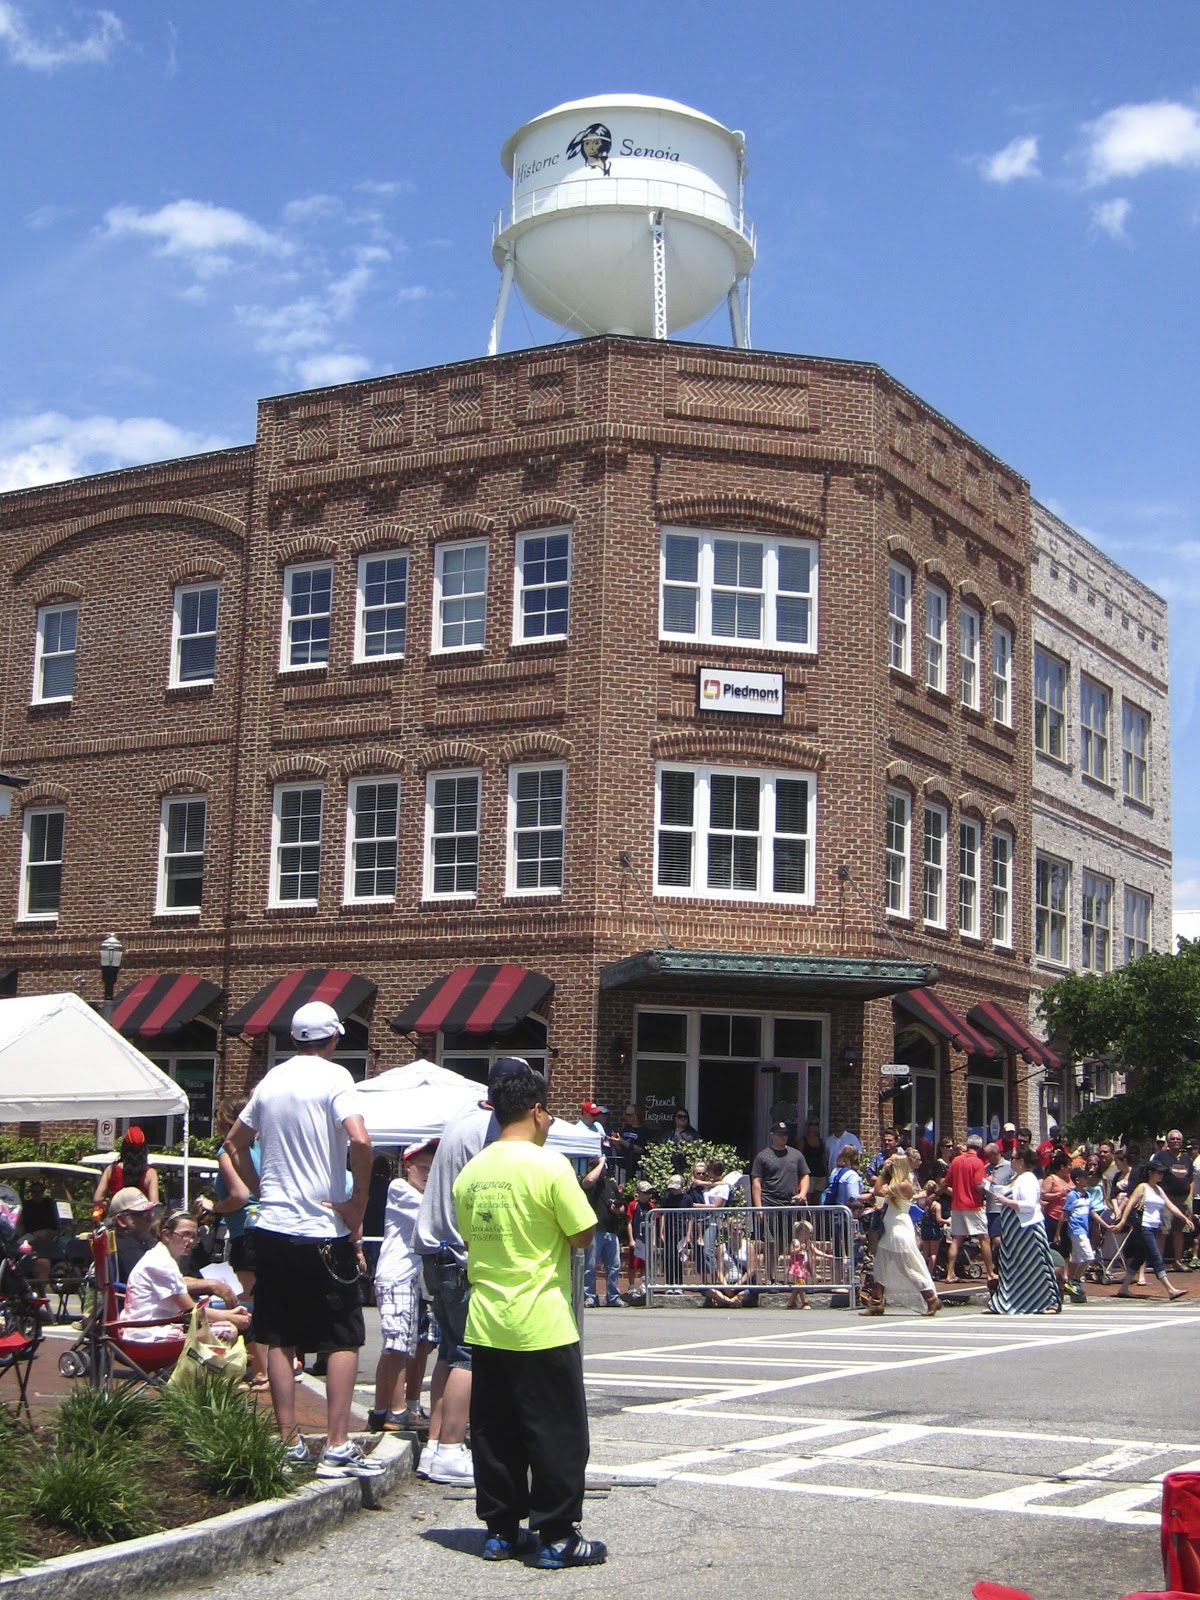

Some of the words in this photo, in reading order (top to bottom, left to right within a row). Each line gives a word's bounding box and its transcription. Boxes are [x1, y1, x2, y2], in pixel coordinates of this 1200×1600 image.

[516, 153, 560, 187] Historic
[619, 138, 680, 163] Senoia
[723, 683, 779, 699] Piedmont
[645, 1094, 676, 1109] French
[467, 1180, 512, 1193] American
